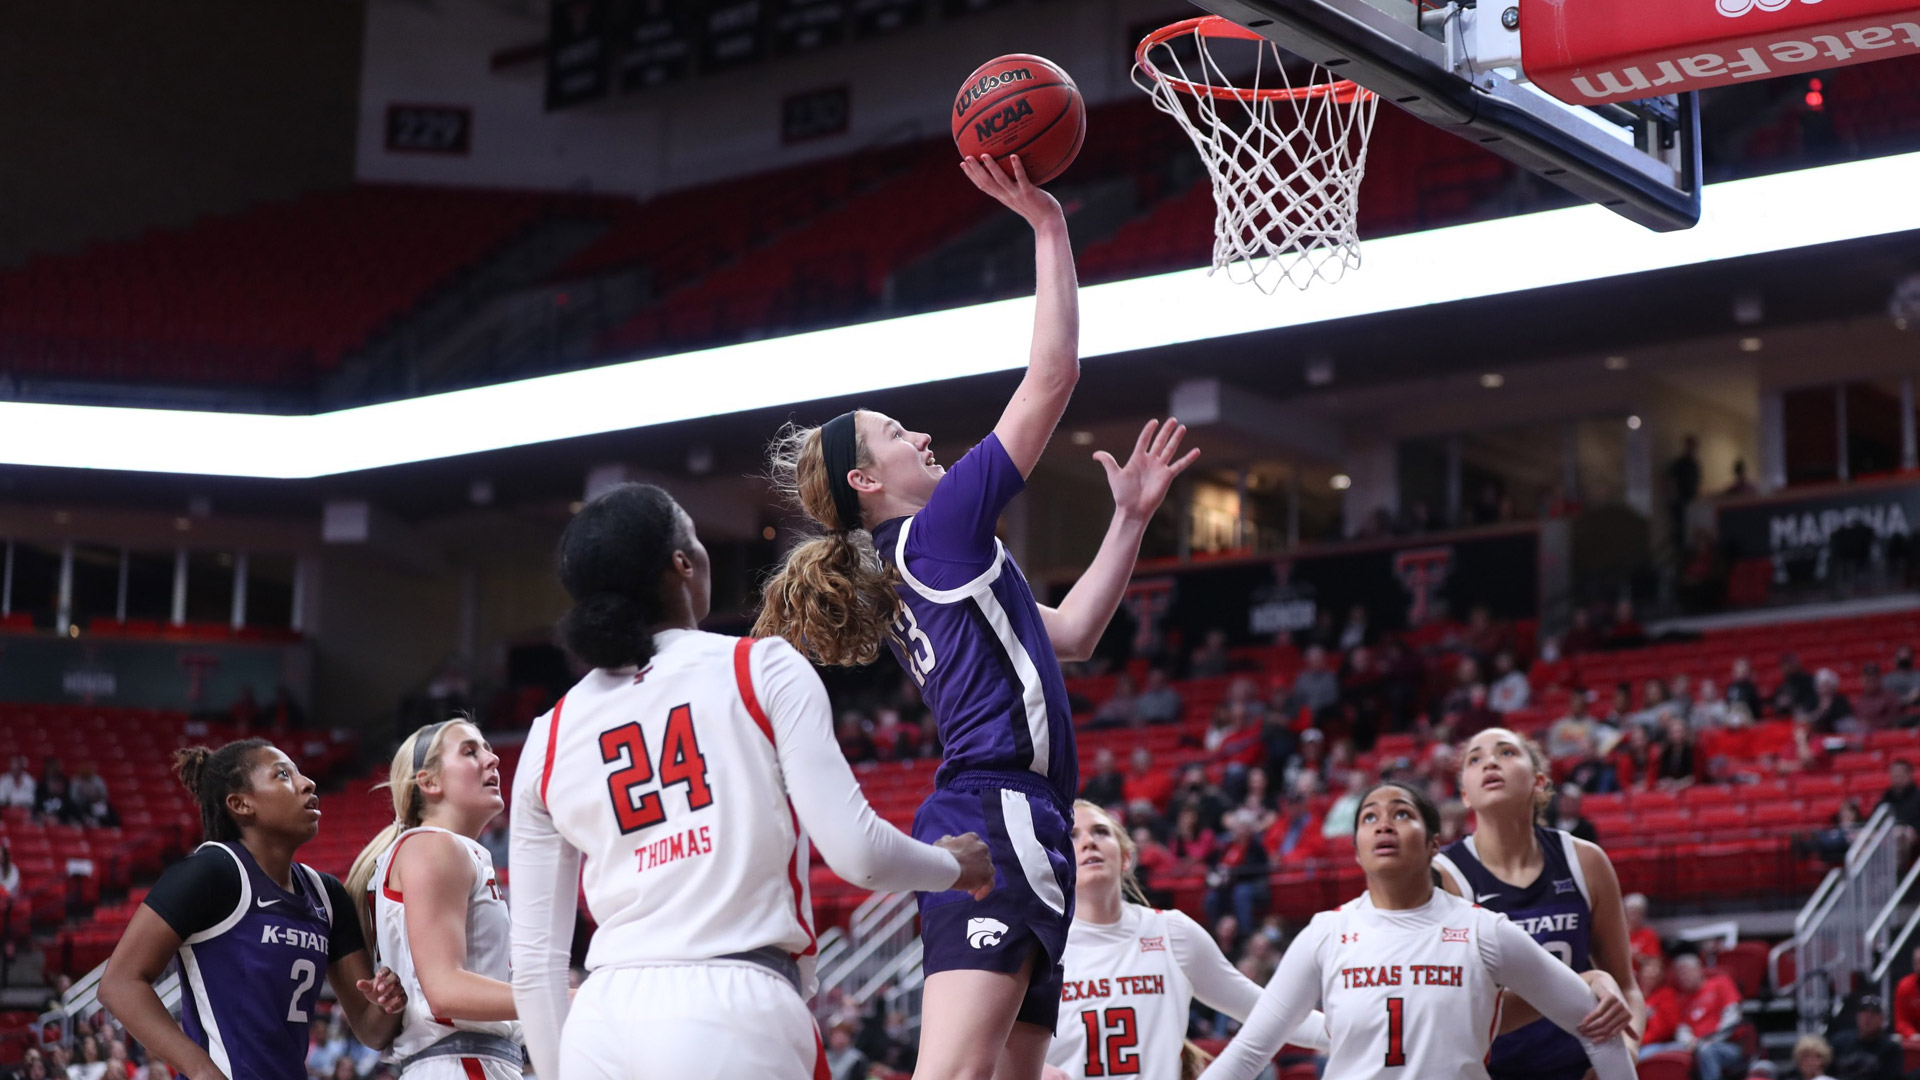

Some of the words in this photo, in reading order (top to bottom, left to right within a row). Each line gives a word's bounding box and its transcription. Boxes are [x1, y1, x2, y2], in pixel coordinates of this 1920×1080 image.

[955, 67, 1034, 118] Wilson
[974, 99, 1034, 142] NCAA
[598, 702, 714, 836] 24
[634, 826, 713, 873] THOMAS
[260, 925, 330, 956] K-STATE
[286, 958, 317, 1023] 2
[1061, 978, 1111, 1002] EXAS
[1115, 975, 1165, 996] TECH
[1342, 966, 1402, 989] TEXAS
[1409, 965, 1463, 987] TECH
[1081, 1006, 1140, 1077] 12
[1384, 997, 1406, 1067] 1
